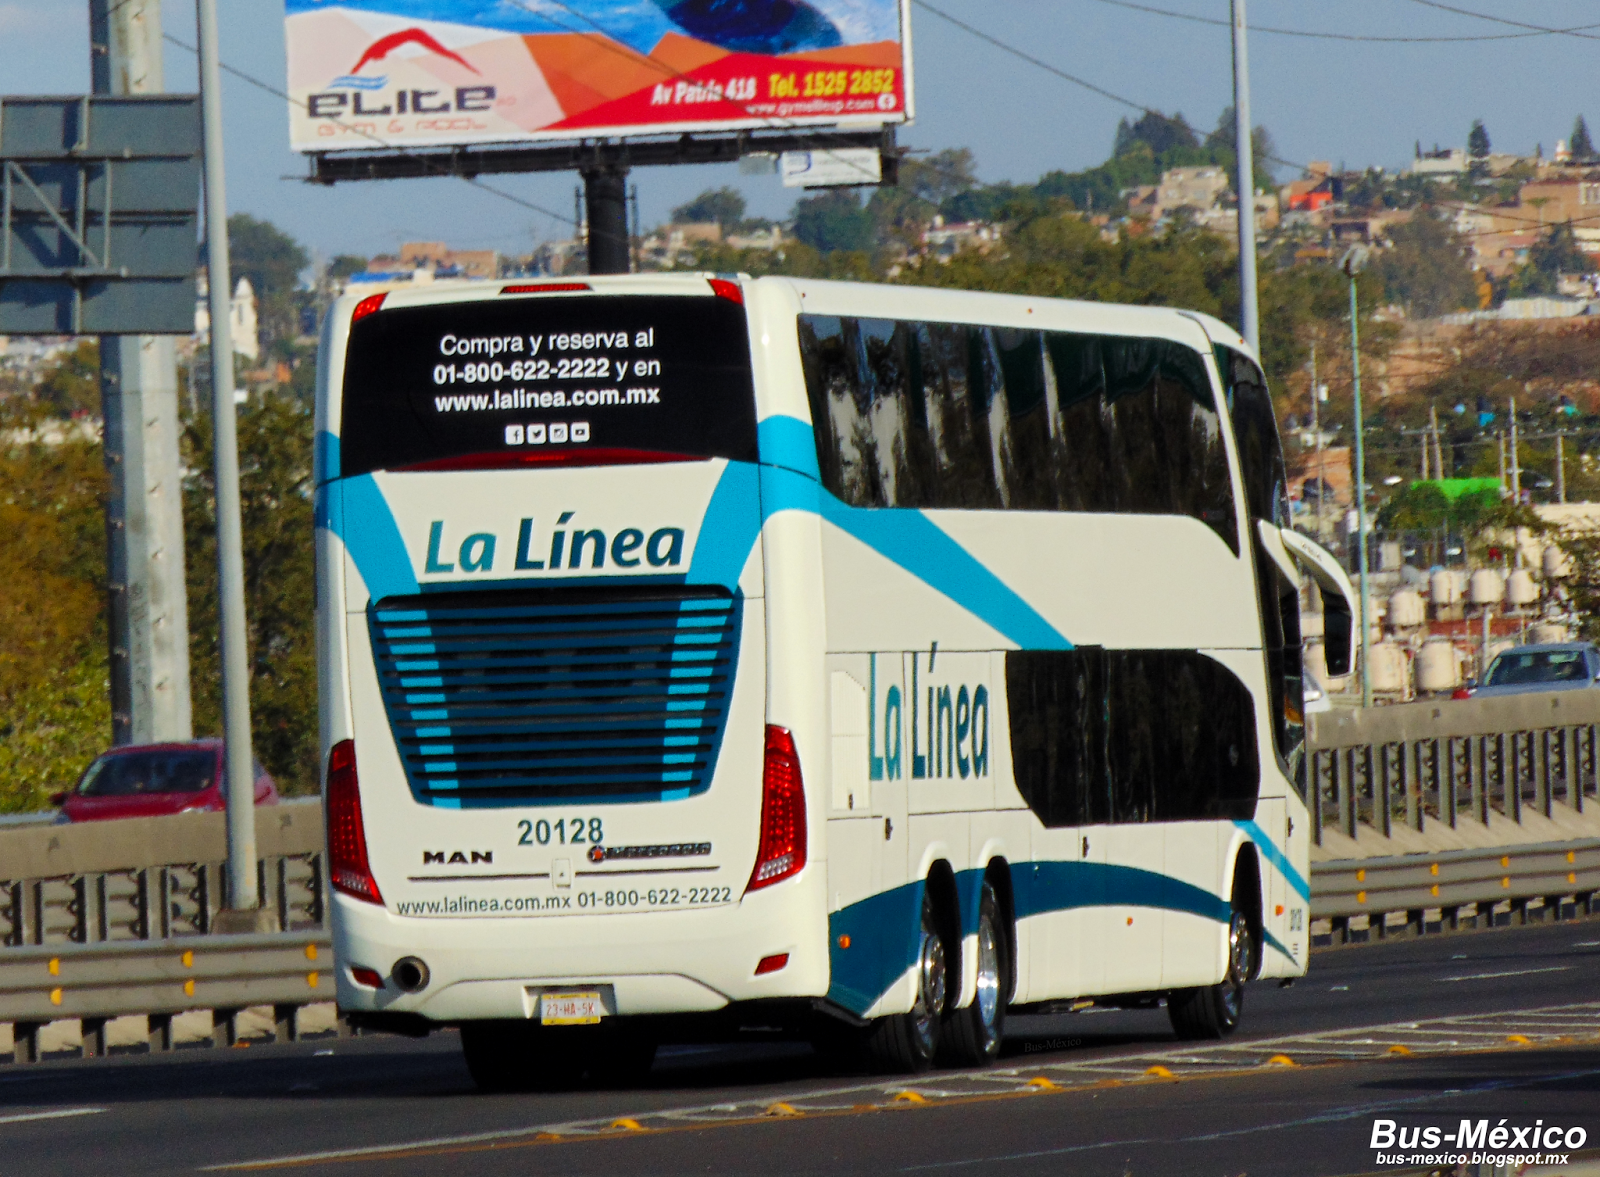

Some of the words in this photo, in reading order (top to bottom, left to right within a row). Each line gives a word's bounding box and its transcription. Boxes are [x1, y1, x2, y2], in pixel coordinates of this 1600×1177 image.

[652, 83, 673, 105] Av
[675, 79, 722, 104] Patria
[725, 77, 757, 101] 418
[769, 73, 799, 97] Tel.
[804, 71, 847, 97] 1525
[850, 68, 894, 94] 2852
[440, 333, 523, 358] Compra
[530, 336, 542, 356] y
[549, 331, 629, 351] reserva
[635, 327, 654, 349] al
[433, 358, 610, 385] 01-800-622-2222
[616, 362, 628, 380] y
[635, 359, 661, 377] en
[435, 386, 661, 413] www.lalinea.com.mx
[424, 520, 497, 575] La
[514, 512, 685, 573] Línea
[869, 651, 901, 781] La
[911, 640, 989, 780] Línea
[517, 817, 604, 846] 20128
[423, 850, 494, 865] MAN
[397, 893, 571, 915] www.lalinea.com.mx
[577, 887, 732, 907] 01-800-622-2222
